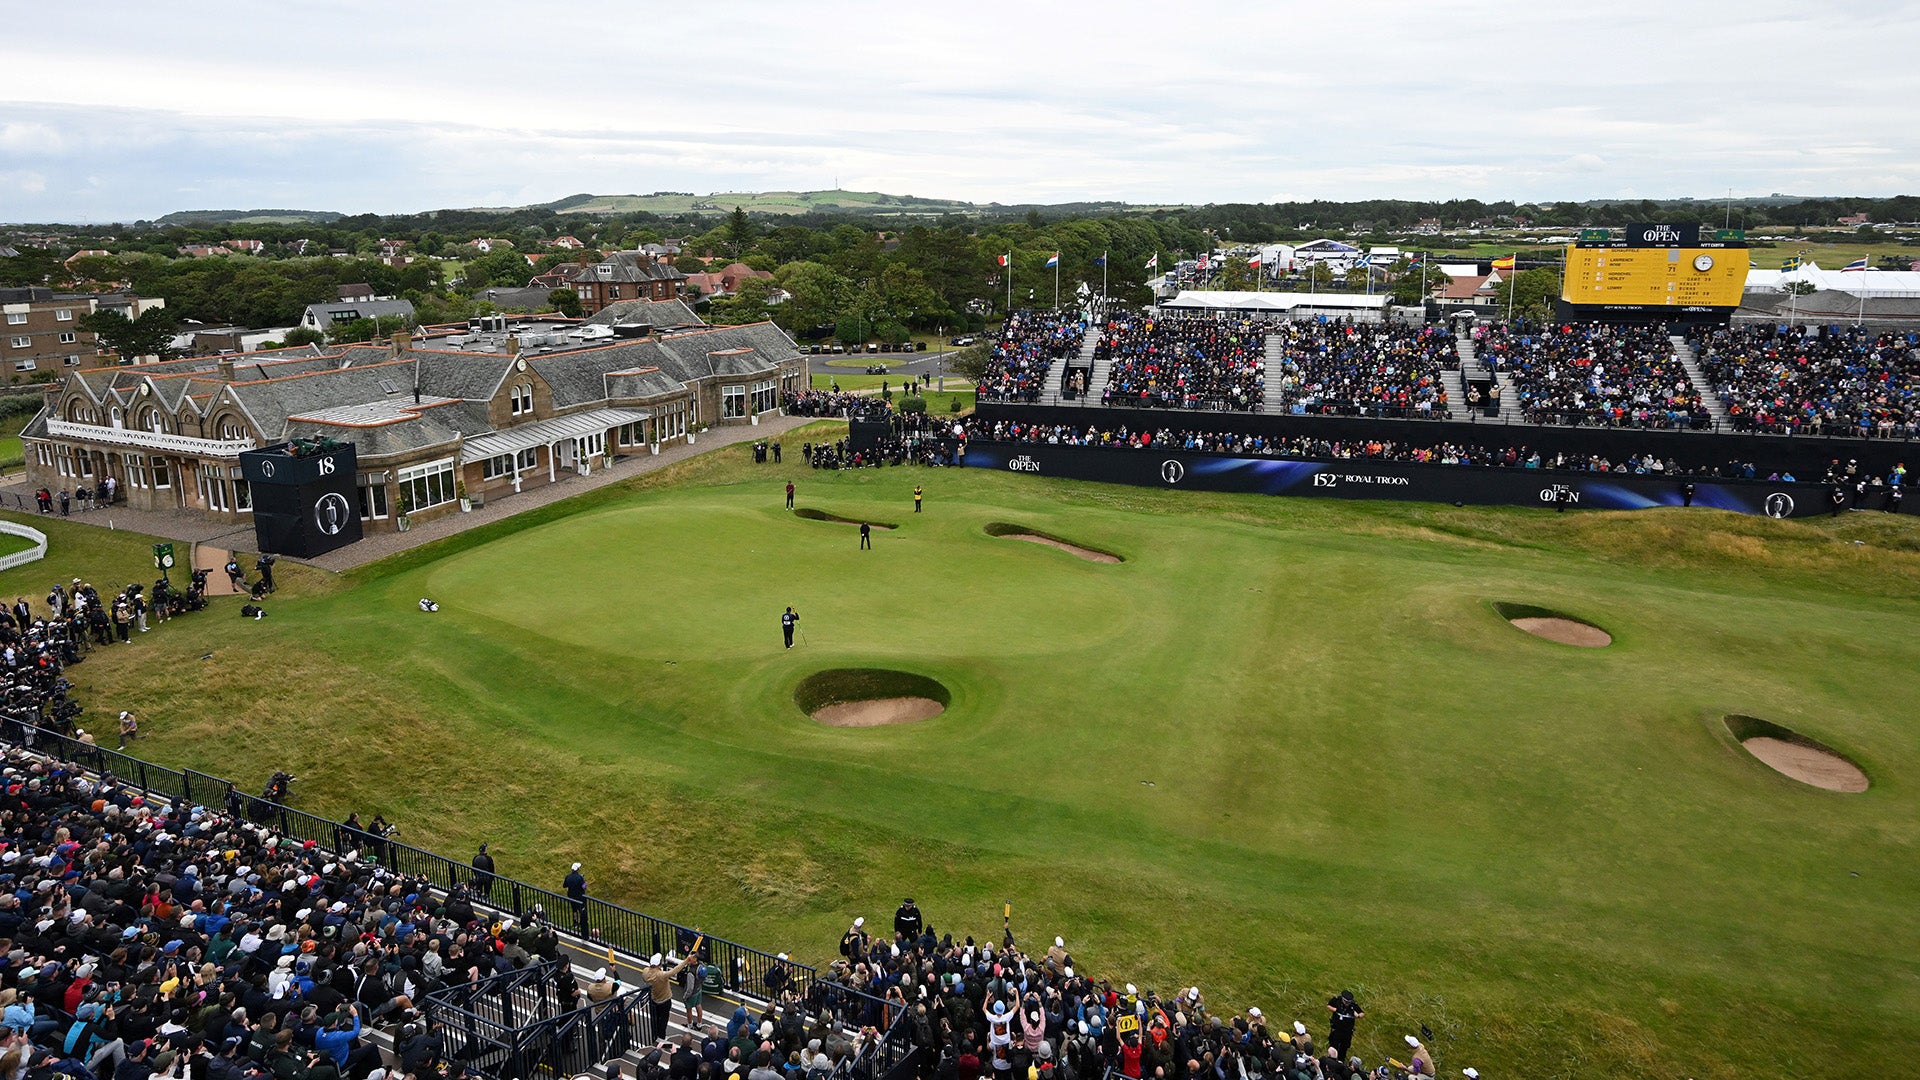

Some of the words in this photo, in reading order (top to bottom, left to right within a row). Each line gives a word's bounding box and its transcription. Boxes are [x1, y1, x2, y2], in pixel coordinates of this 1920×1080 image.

[1643, 229, 1681, 241] OPEN
[317, 456, 336, 476] 18
[1009, 459, 1040, 471] OPEN
[1345, 474, 1374, 483] ROYAL
[1375, 475, 1410, 485] TROON
[1540, 488, 1580, 503] ON
